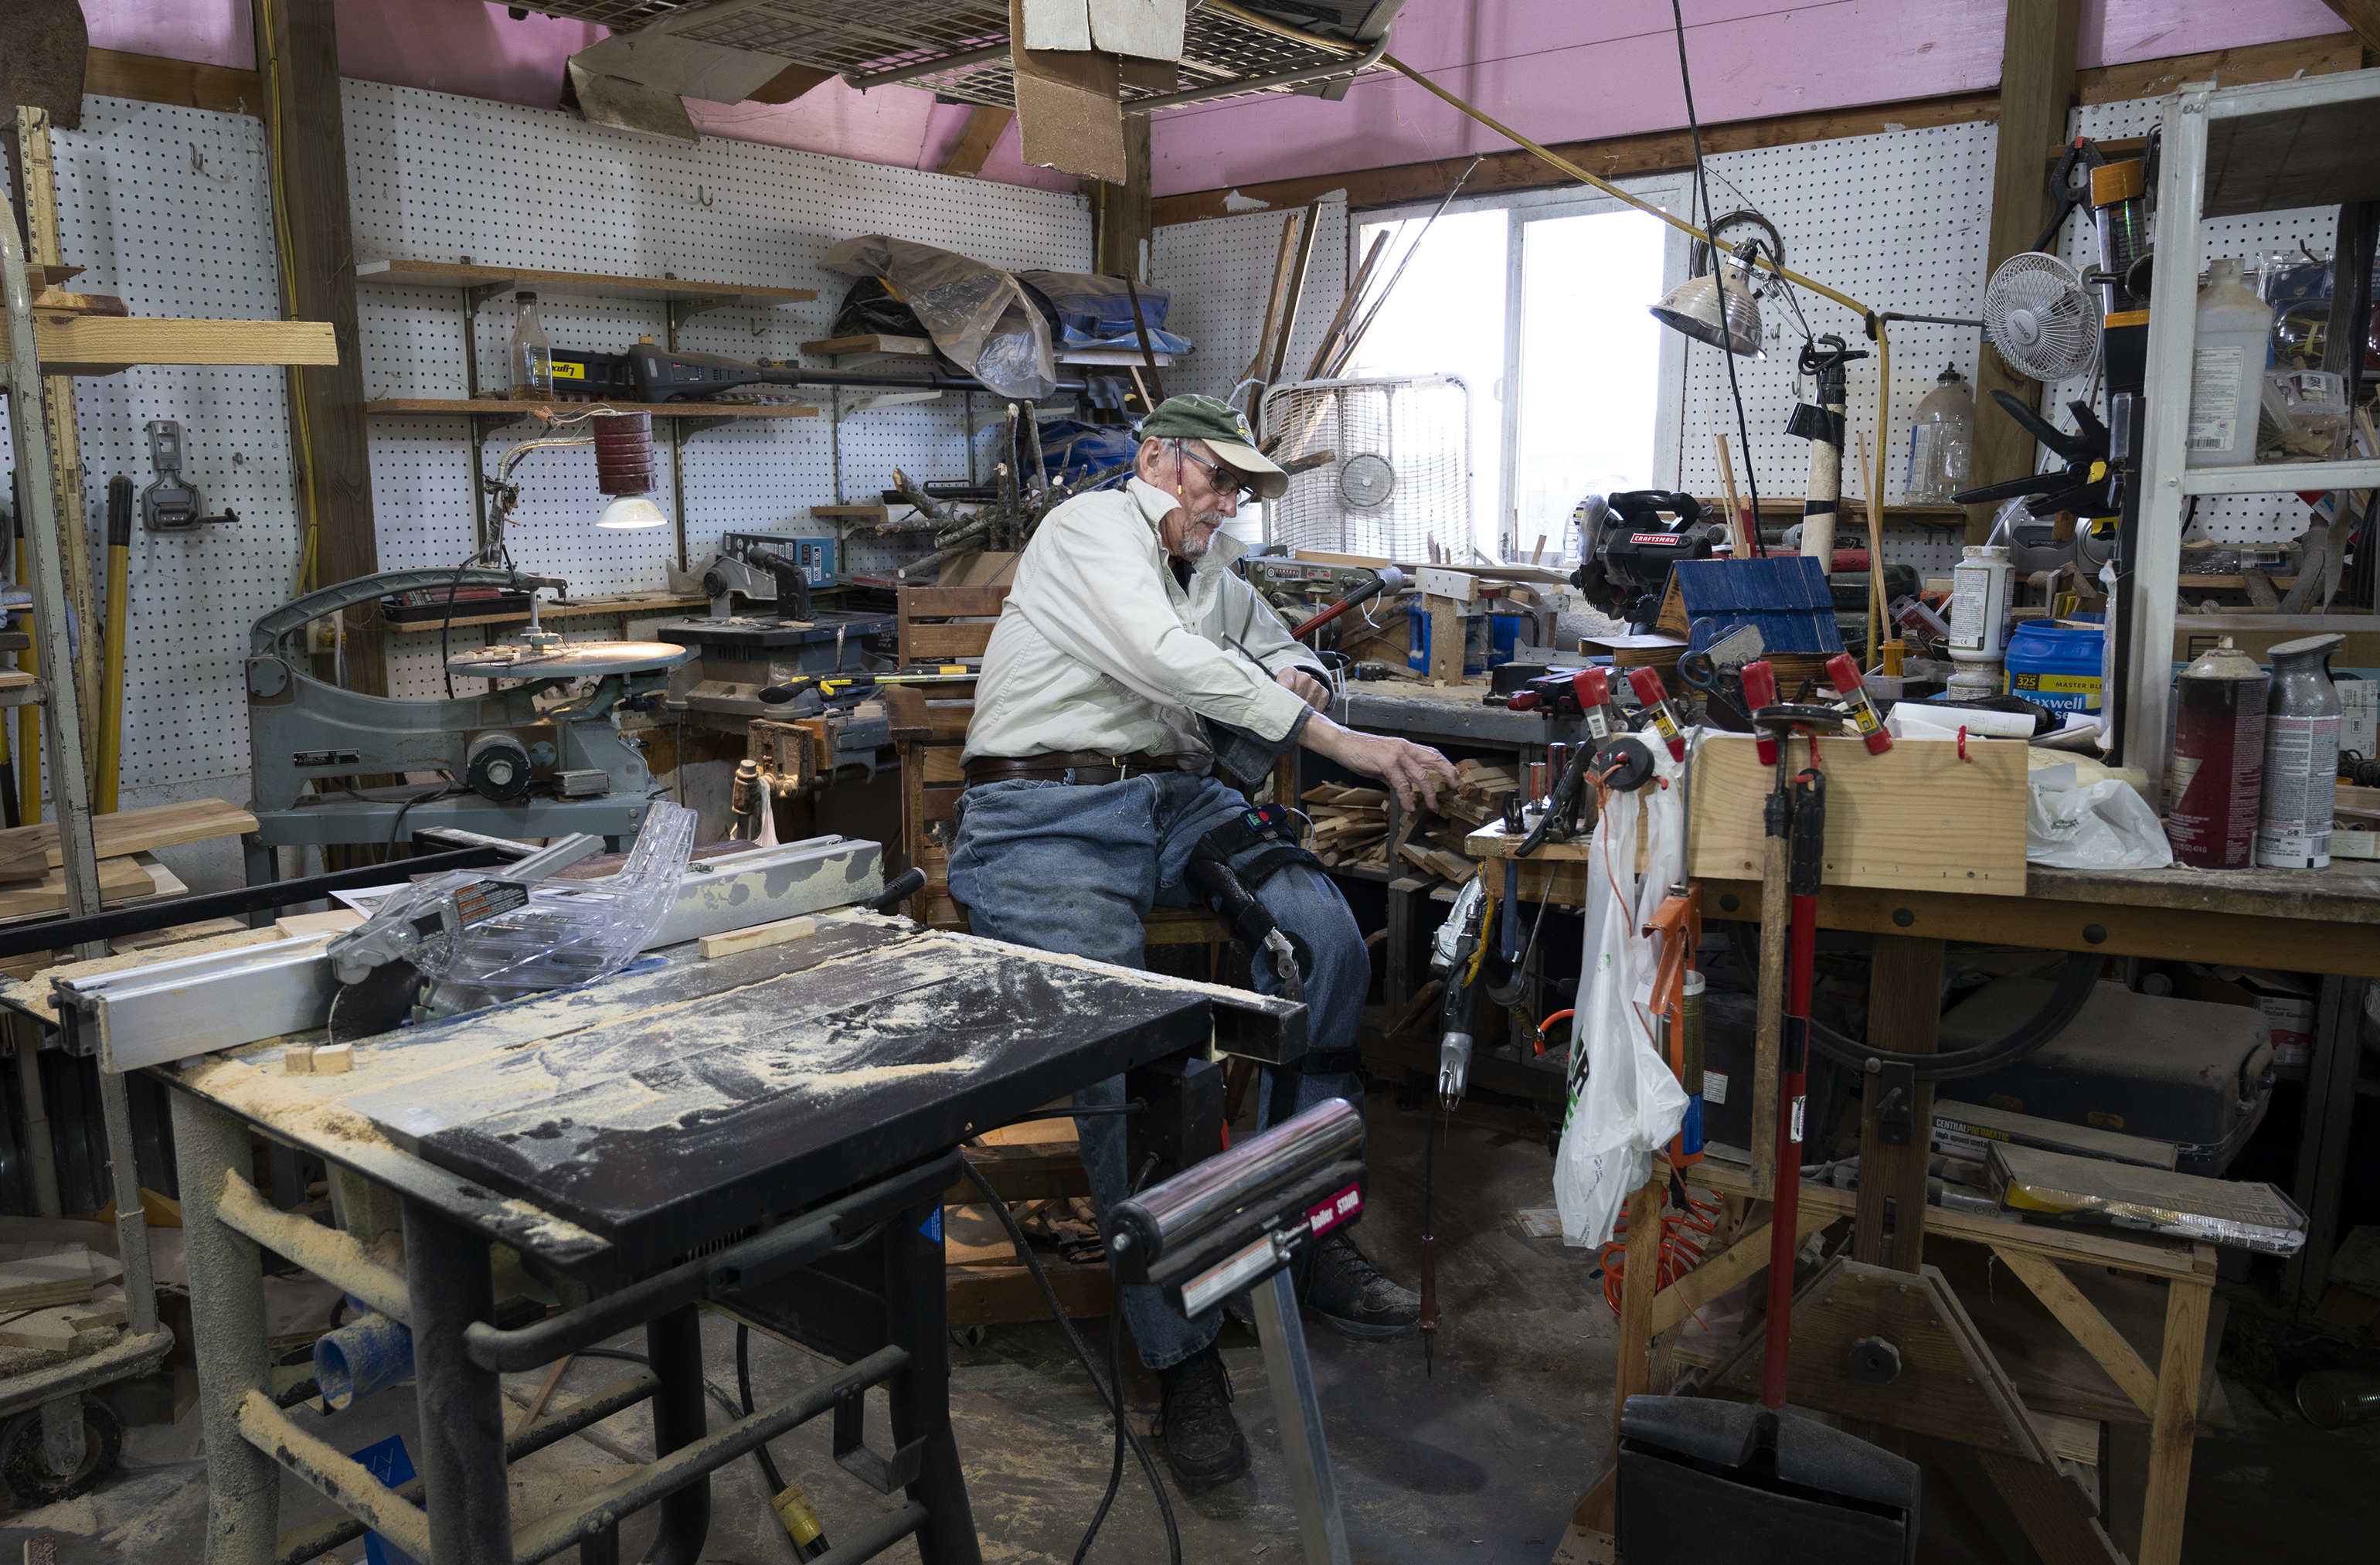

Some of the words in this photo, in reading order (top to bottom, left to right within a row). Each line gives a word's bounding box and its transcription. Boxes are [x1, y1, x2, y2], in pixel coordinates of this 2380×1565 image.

[22, 134, 27, 143] 46
[23, 151, 29, 159] 45
[25, 167, 30, 175] 44
[26, 183, 32, 192] 43
[28, 199, 34, 208] 42
[31, 231, 37, 240] 40
[32, 247, 39, 255] 39
[552, 364, 575, 376] Lynx
[2310, 376, 2321, 389] GRK
[46, 387, 53, 396] 30
[47, 402, 54, 410] 29
[49, 417, 56, 426] 28
[51, 433, 57, 441] 27
[58, 509, 64, 517] 22
[60, 524, 66, 532] 21
[61, 539, 67, 547] 20
[1634, 535, 1675, 543] CRAFTSMAN
[2017, 677, 2036, 686] 325
[423, 929, 444, 941] DELTA
[1935, 1130, 1948, 1141] high
[1950, 1135, 1970, 1144] speed
[1970, 1139, 1987, 1148] meta
[1310, 1207, 1334, 1232] Roller
[1336, 1189, 1360, 1216] STAND
[2259, 1205, 2280, 1215] high
[2232, 1210, 2289, 1226] CENTRAL
[2202, 1232, 2221, 1242] saw
[2222, 1235, 2248, 1247] metal
[2249, 1239, 2276, 1250] speed
[2277, 1243, 2294, 1253] high
